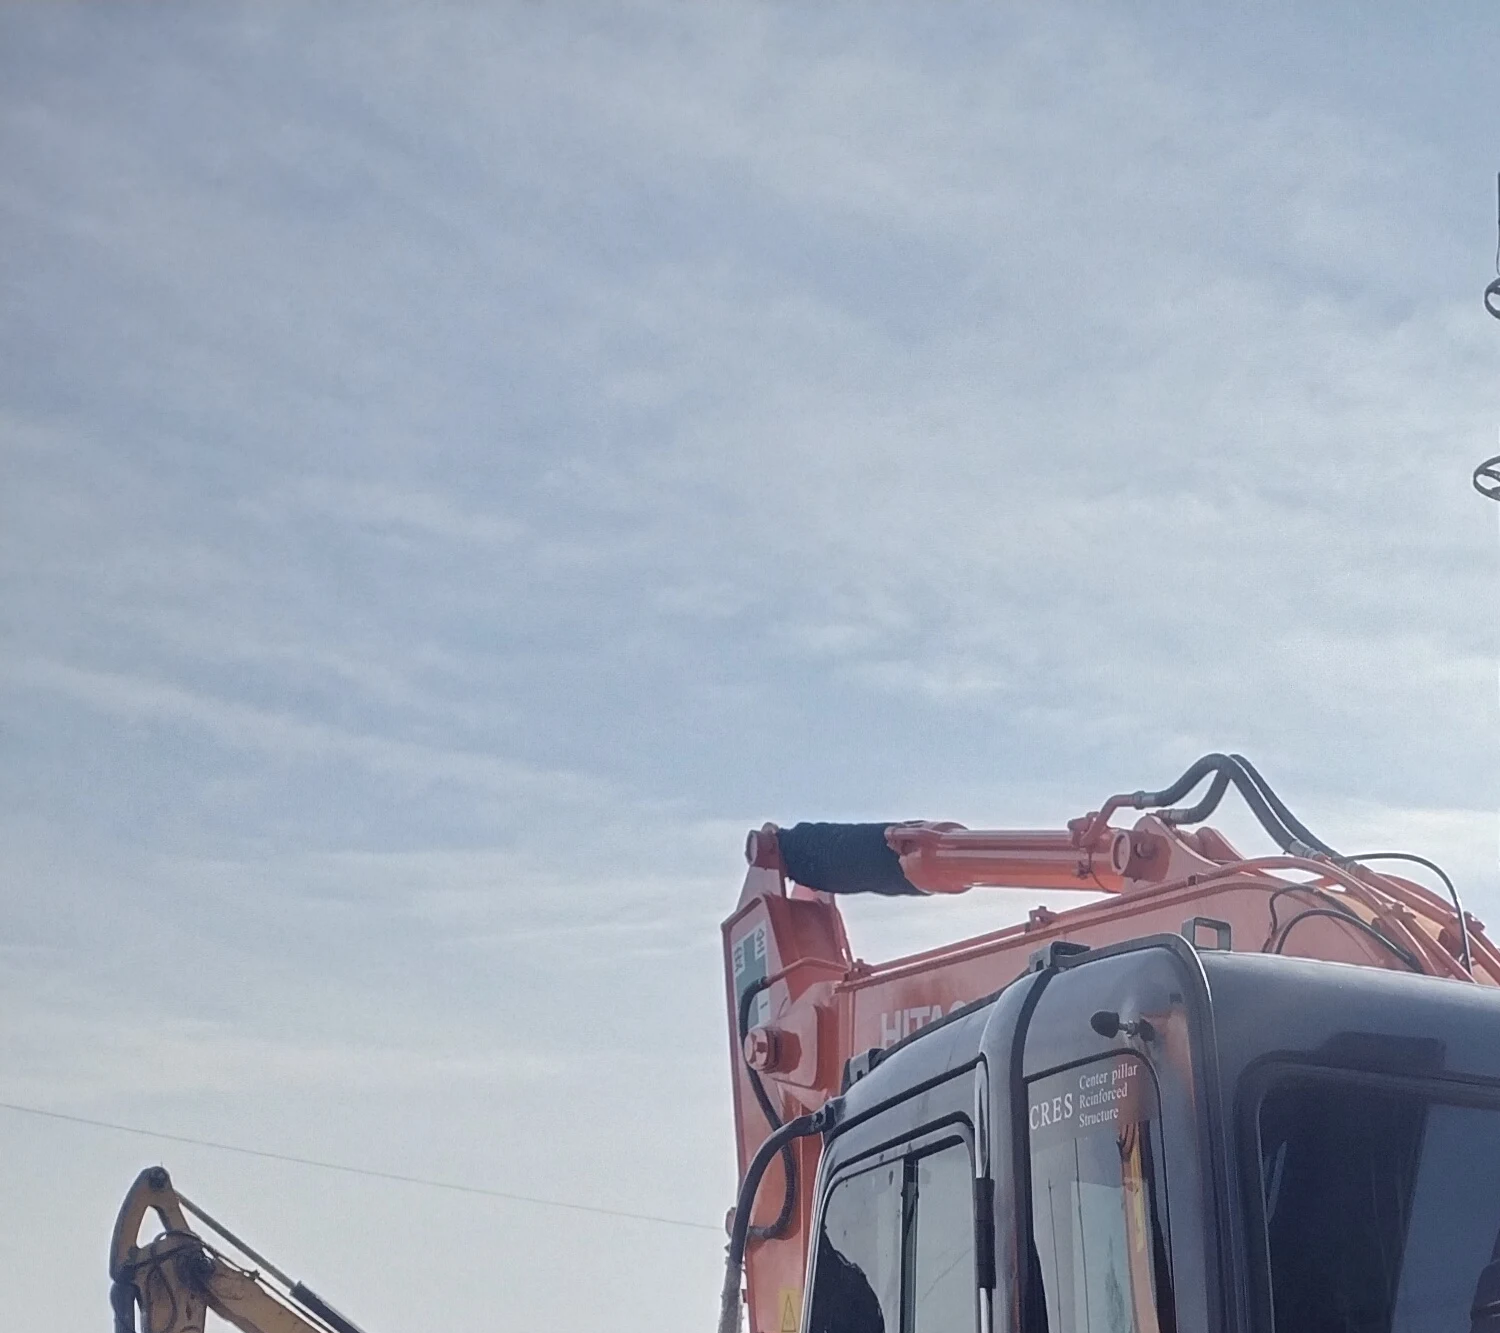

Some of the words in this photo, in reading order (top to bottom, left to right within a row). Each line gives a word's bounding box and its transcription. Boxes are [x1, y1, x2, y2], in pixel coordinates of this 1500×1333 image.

[881, 999, 966, 1050] HIT
[1079, 1072, 1108, 1090] Center
[1111, 1062, 1138, 1085] pillar
[1079, 1083, 1128, 1109] Reinforced
[1029, 1092, 1073, 1130] CRES
[1079, 1107, 1119, 1128] Structure
